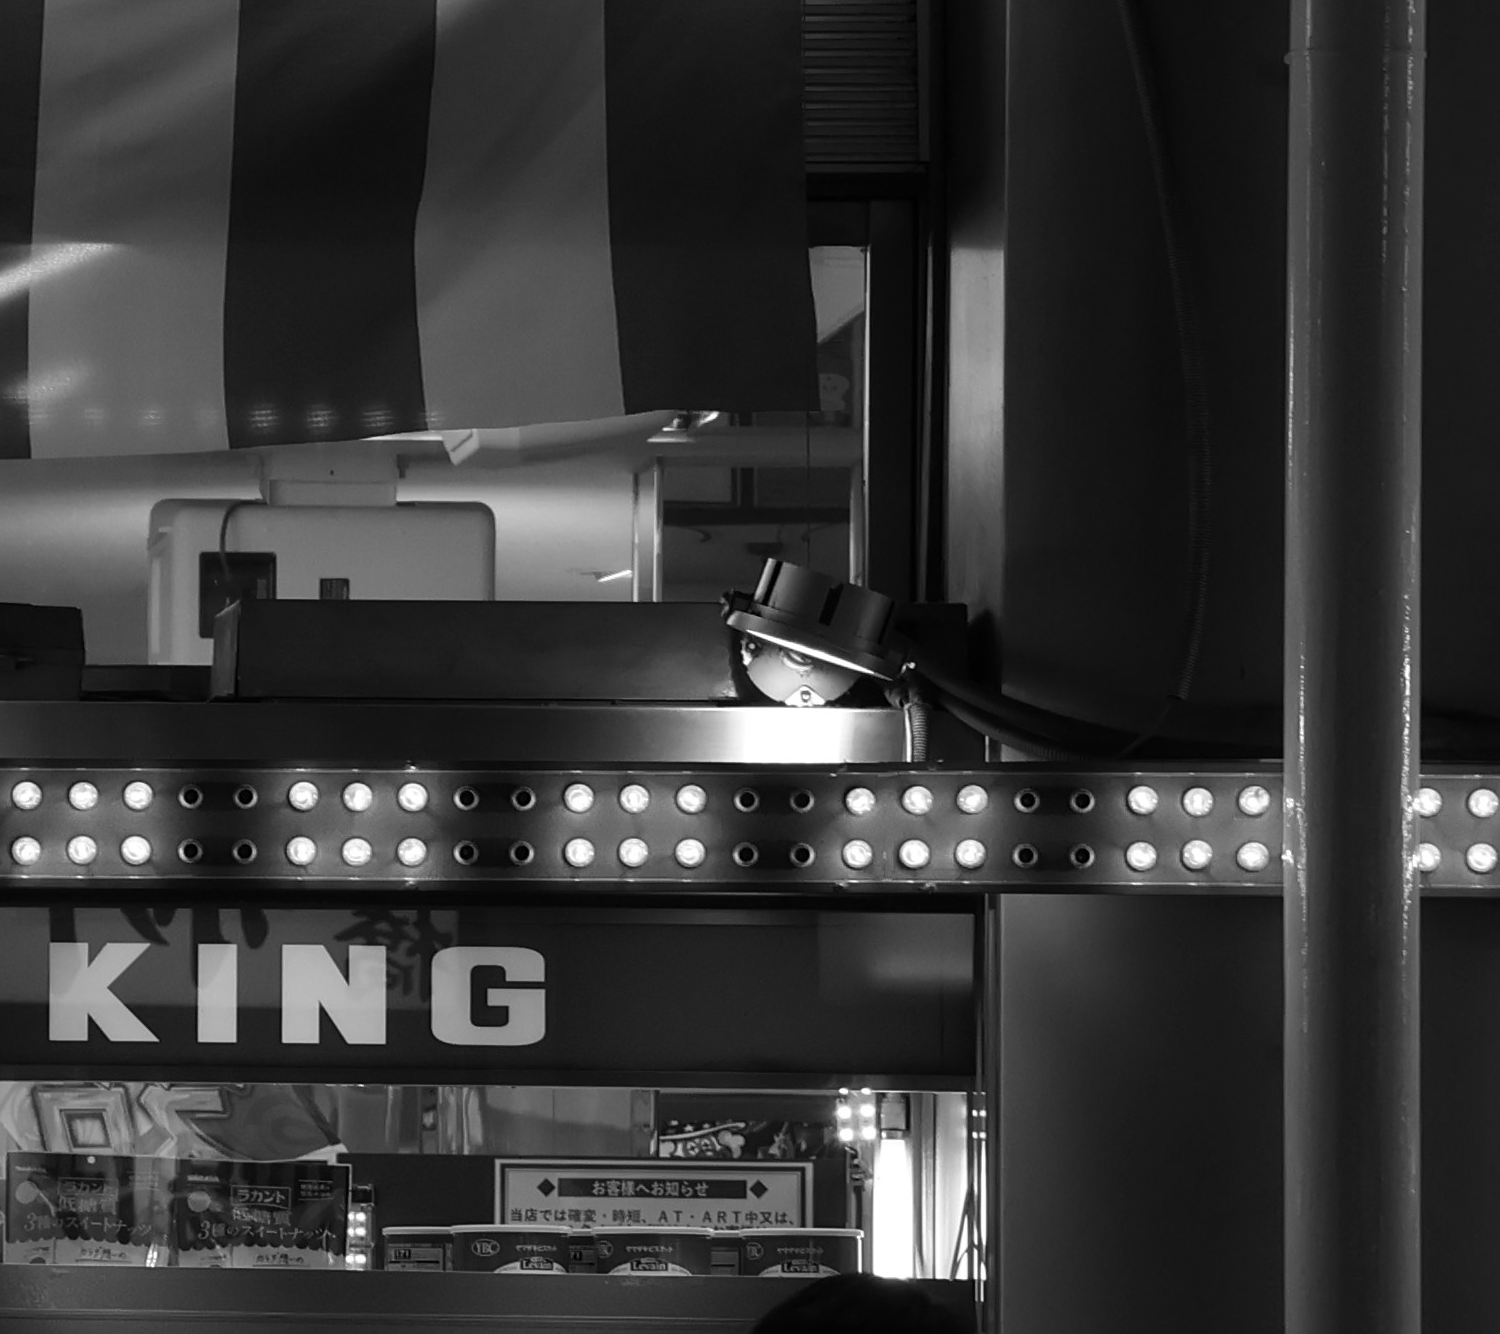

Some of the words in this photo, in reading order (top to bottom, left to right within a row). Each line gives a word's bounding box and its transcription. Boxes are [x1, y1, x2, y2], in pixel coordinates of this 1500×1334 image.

[47, 942, 548, 1047] KING
[237, 1188, 286, 1204] ラカント
[590, 1180, 710, 1197] お客様へお知らせ
